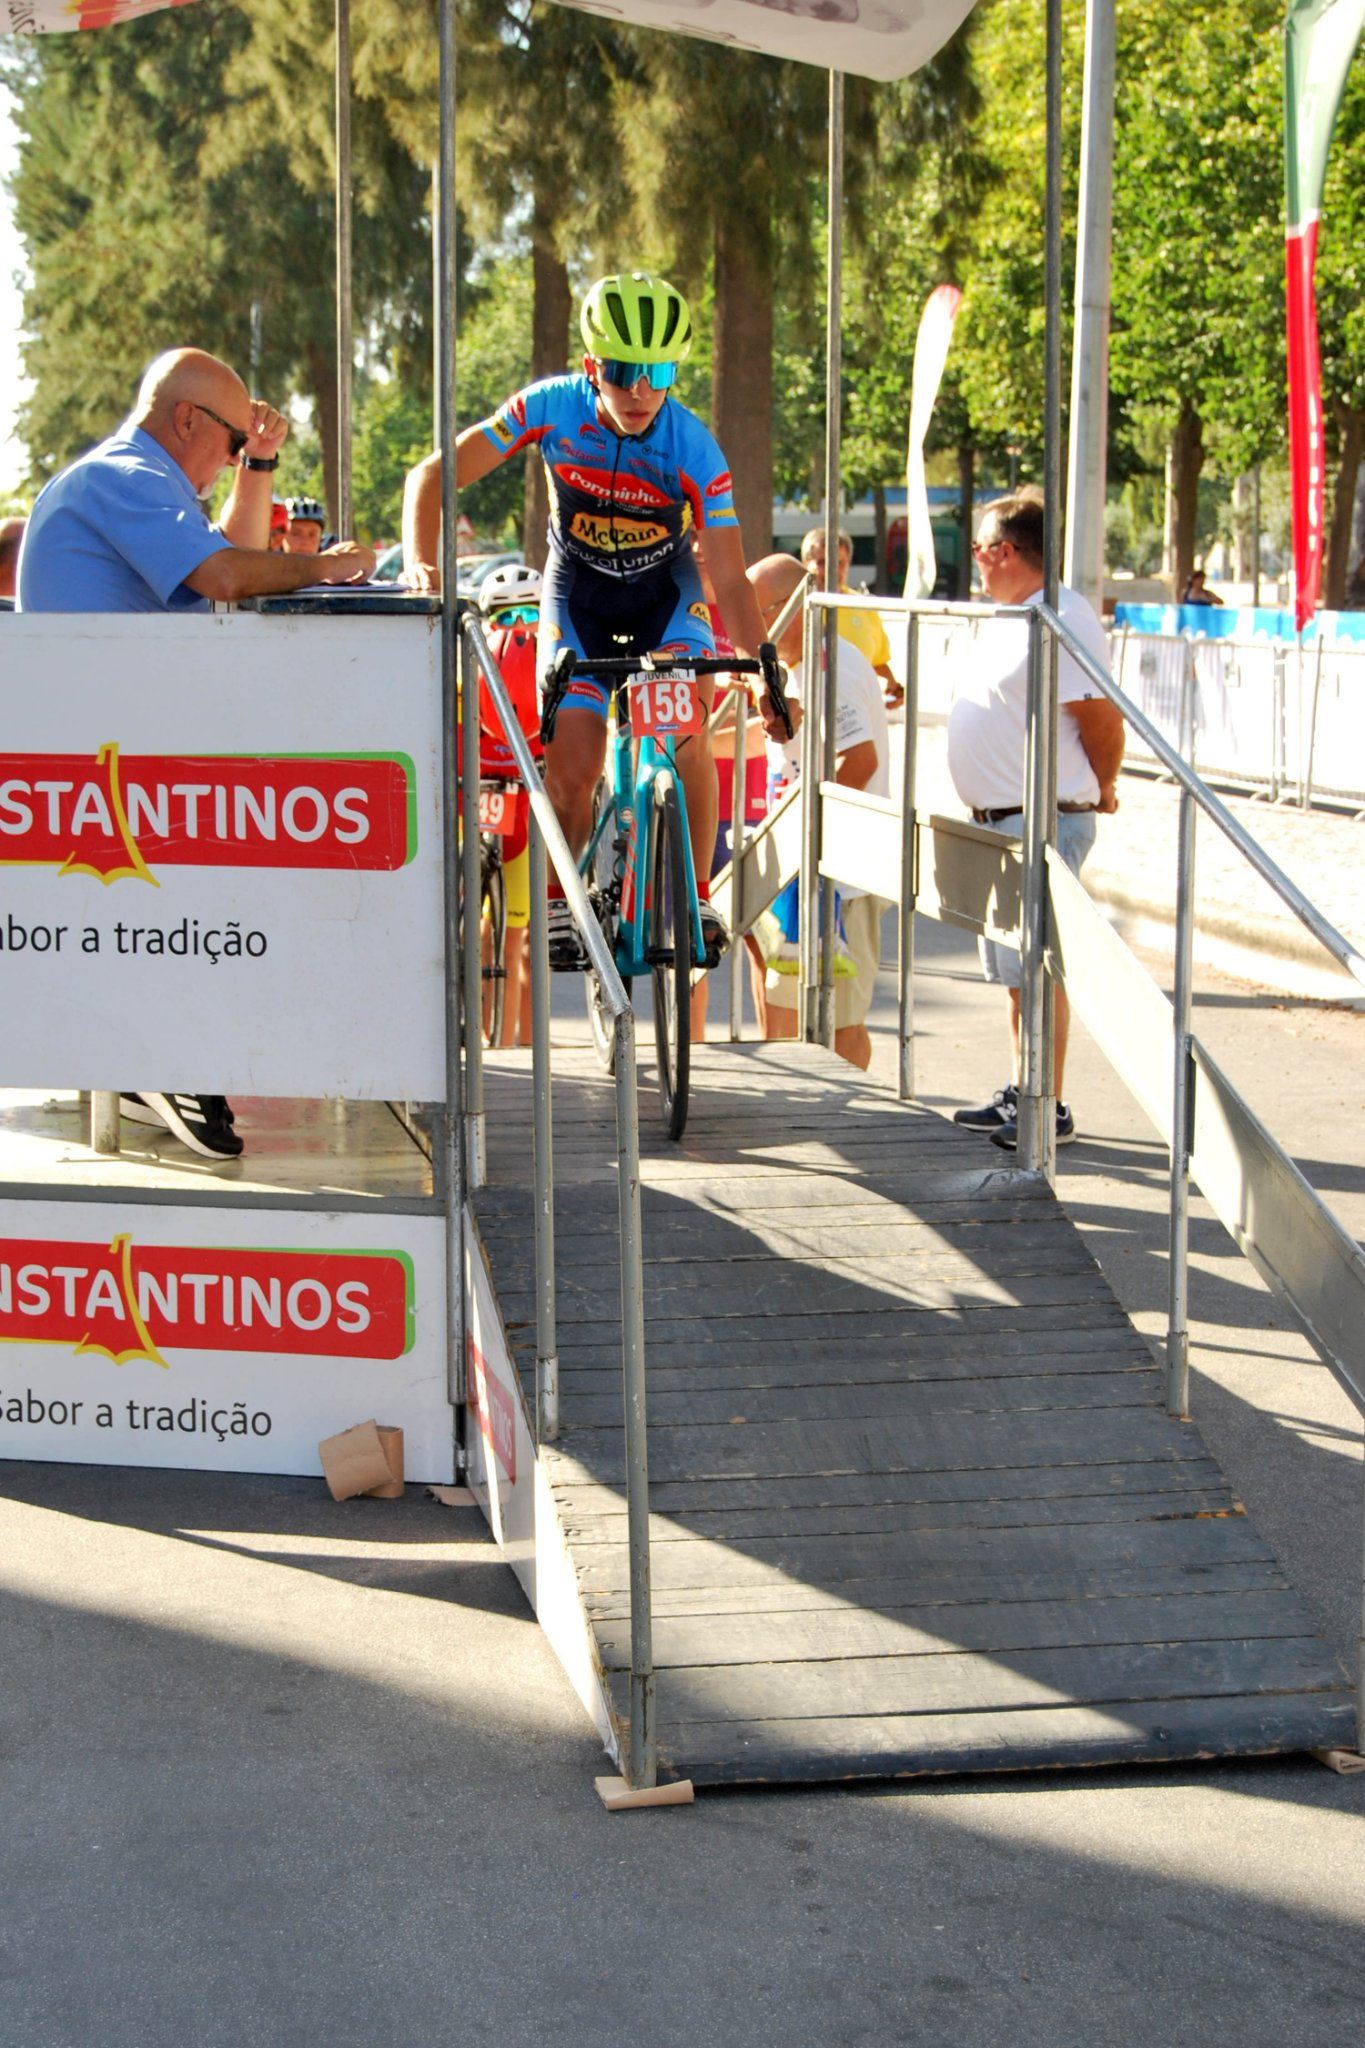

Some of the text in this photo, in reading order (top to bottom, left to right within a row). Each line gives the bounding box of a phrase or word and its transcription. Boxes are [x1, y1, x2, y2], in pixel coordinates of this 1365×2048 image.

[642, 670, 683, 682] JUVENIL
[636, 683, 693, 724] 158
[0, 779, 370, 844] STANTINOS
[0, 914, 268, 965] bor a tradição
[0, 1388, 272, 1443] abor a tradição
